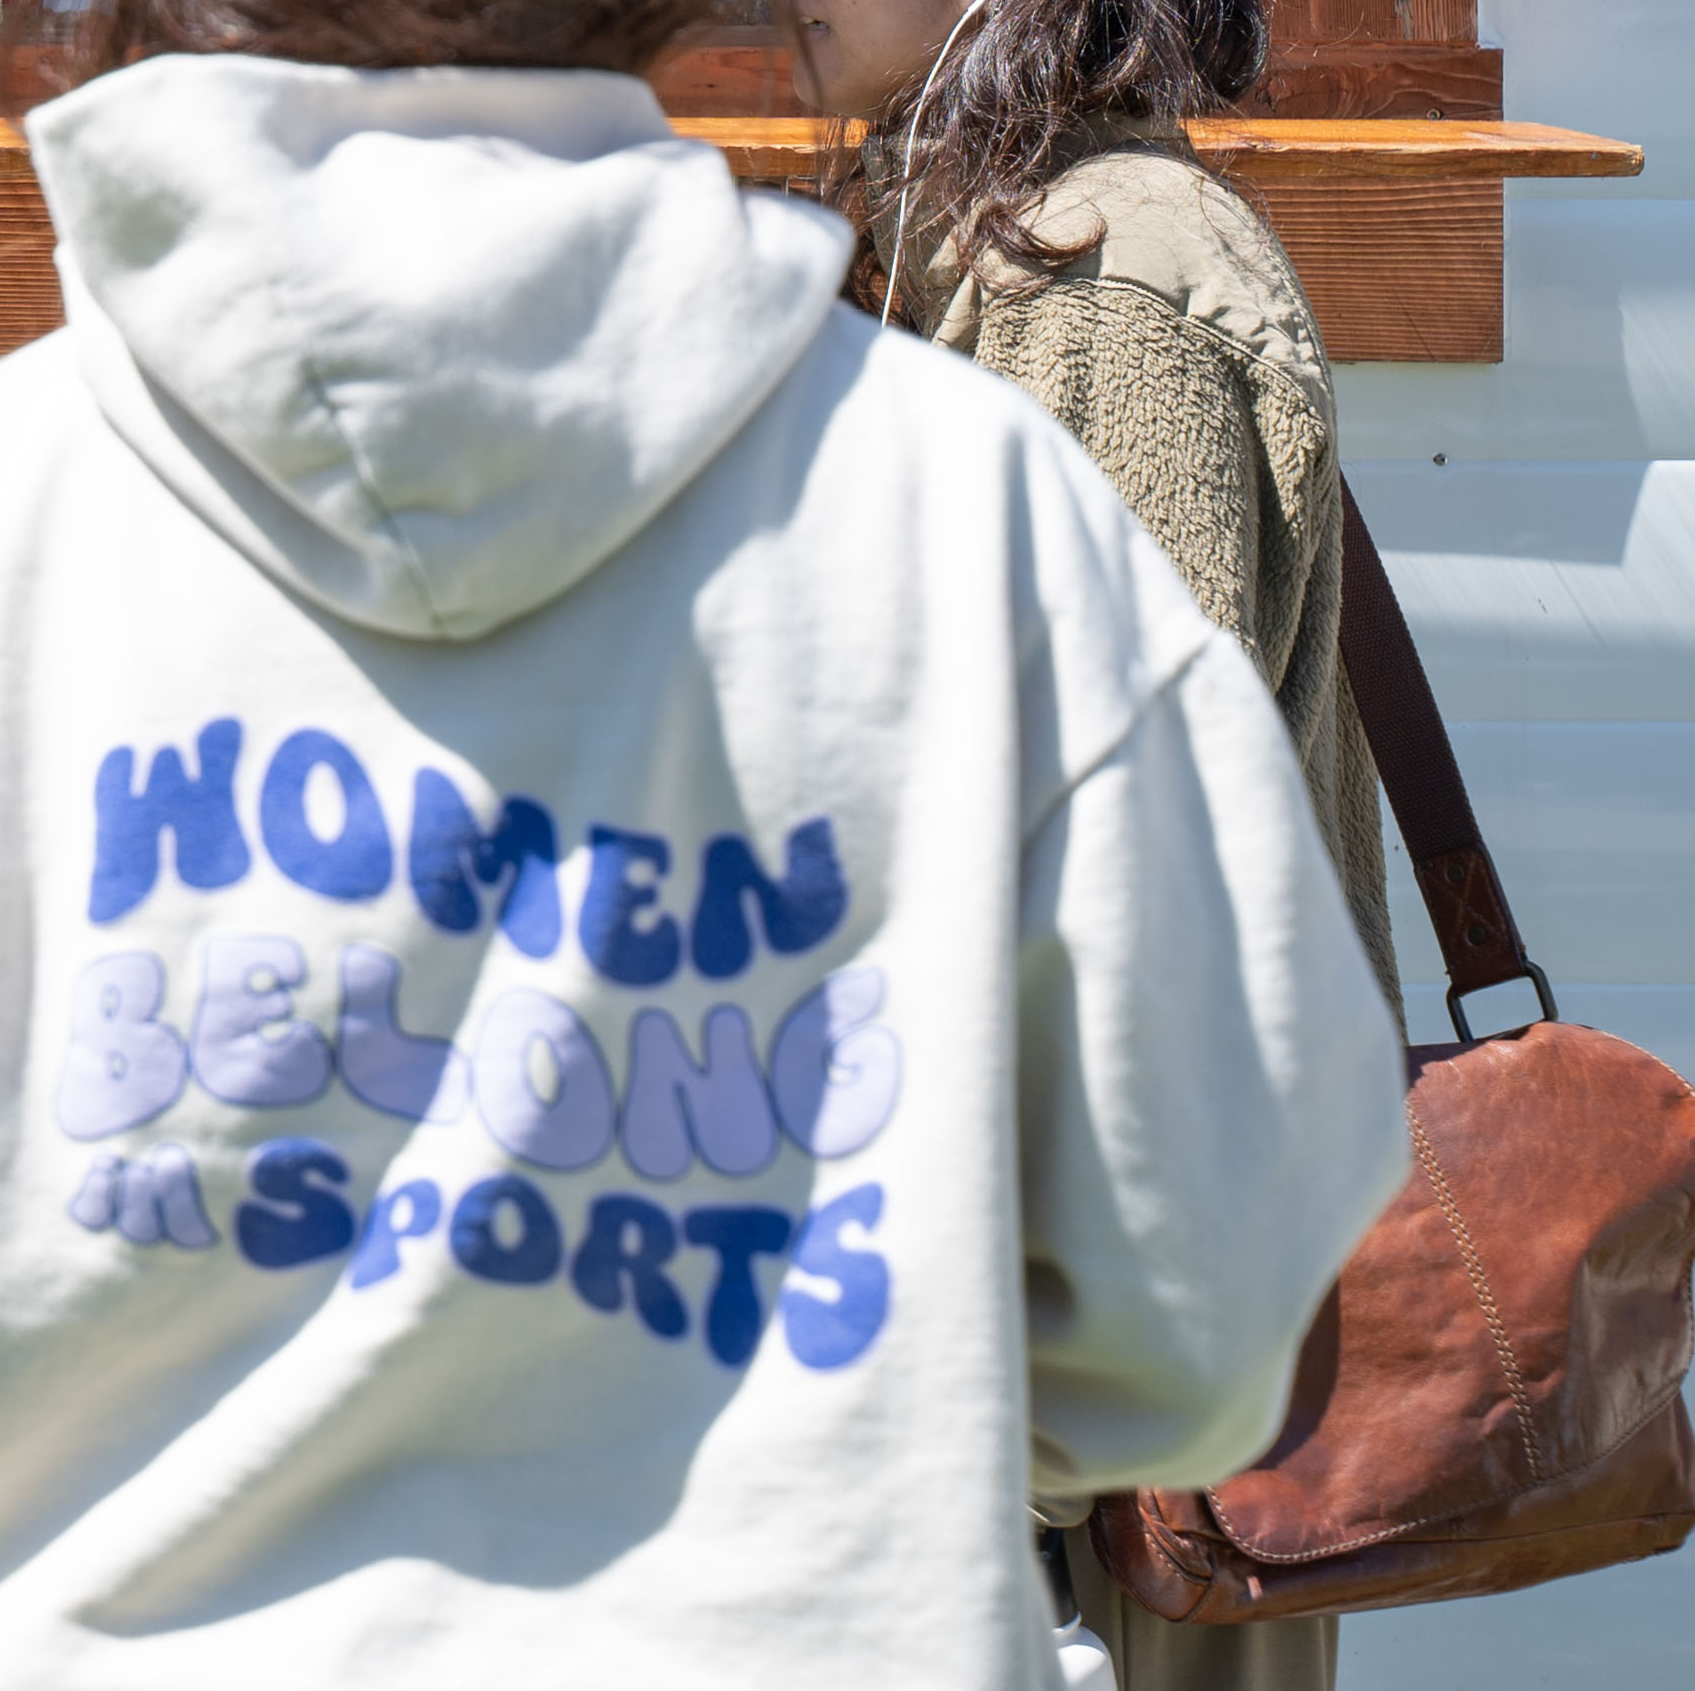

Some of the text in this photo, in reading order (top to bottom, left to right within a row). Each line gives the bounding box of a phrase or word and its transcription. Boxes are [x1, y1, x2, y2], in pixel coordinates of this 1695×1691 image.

[87, 716, 850, 989] WOMEN
[55, 934, 901, 1182] BELONG
[233, 1135, 892, 1370] SPORTS
